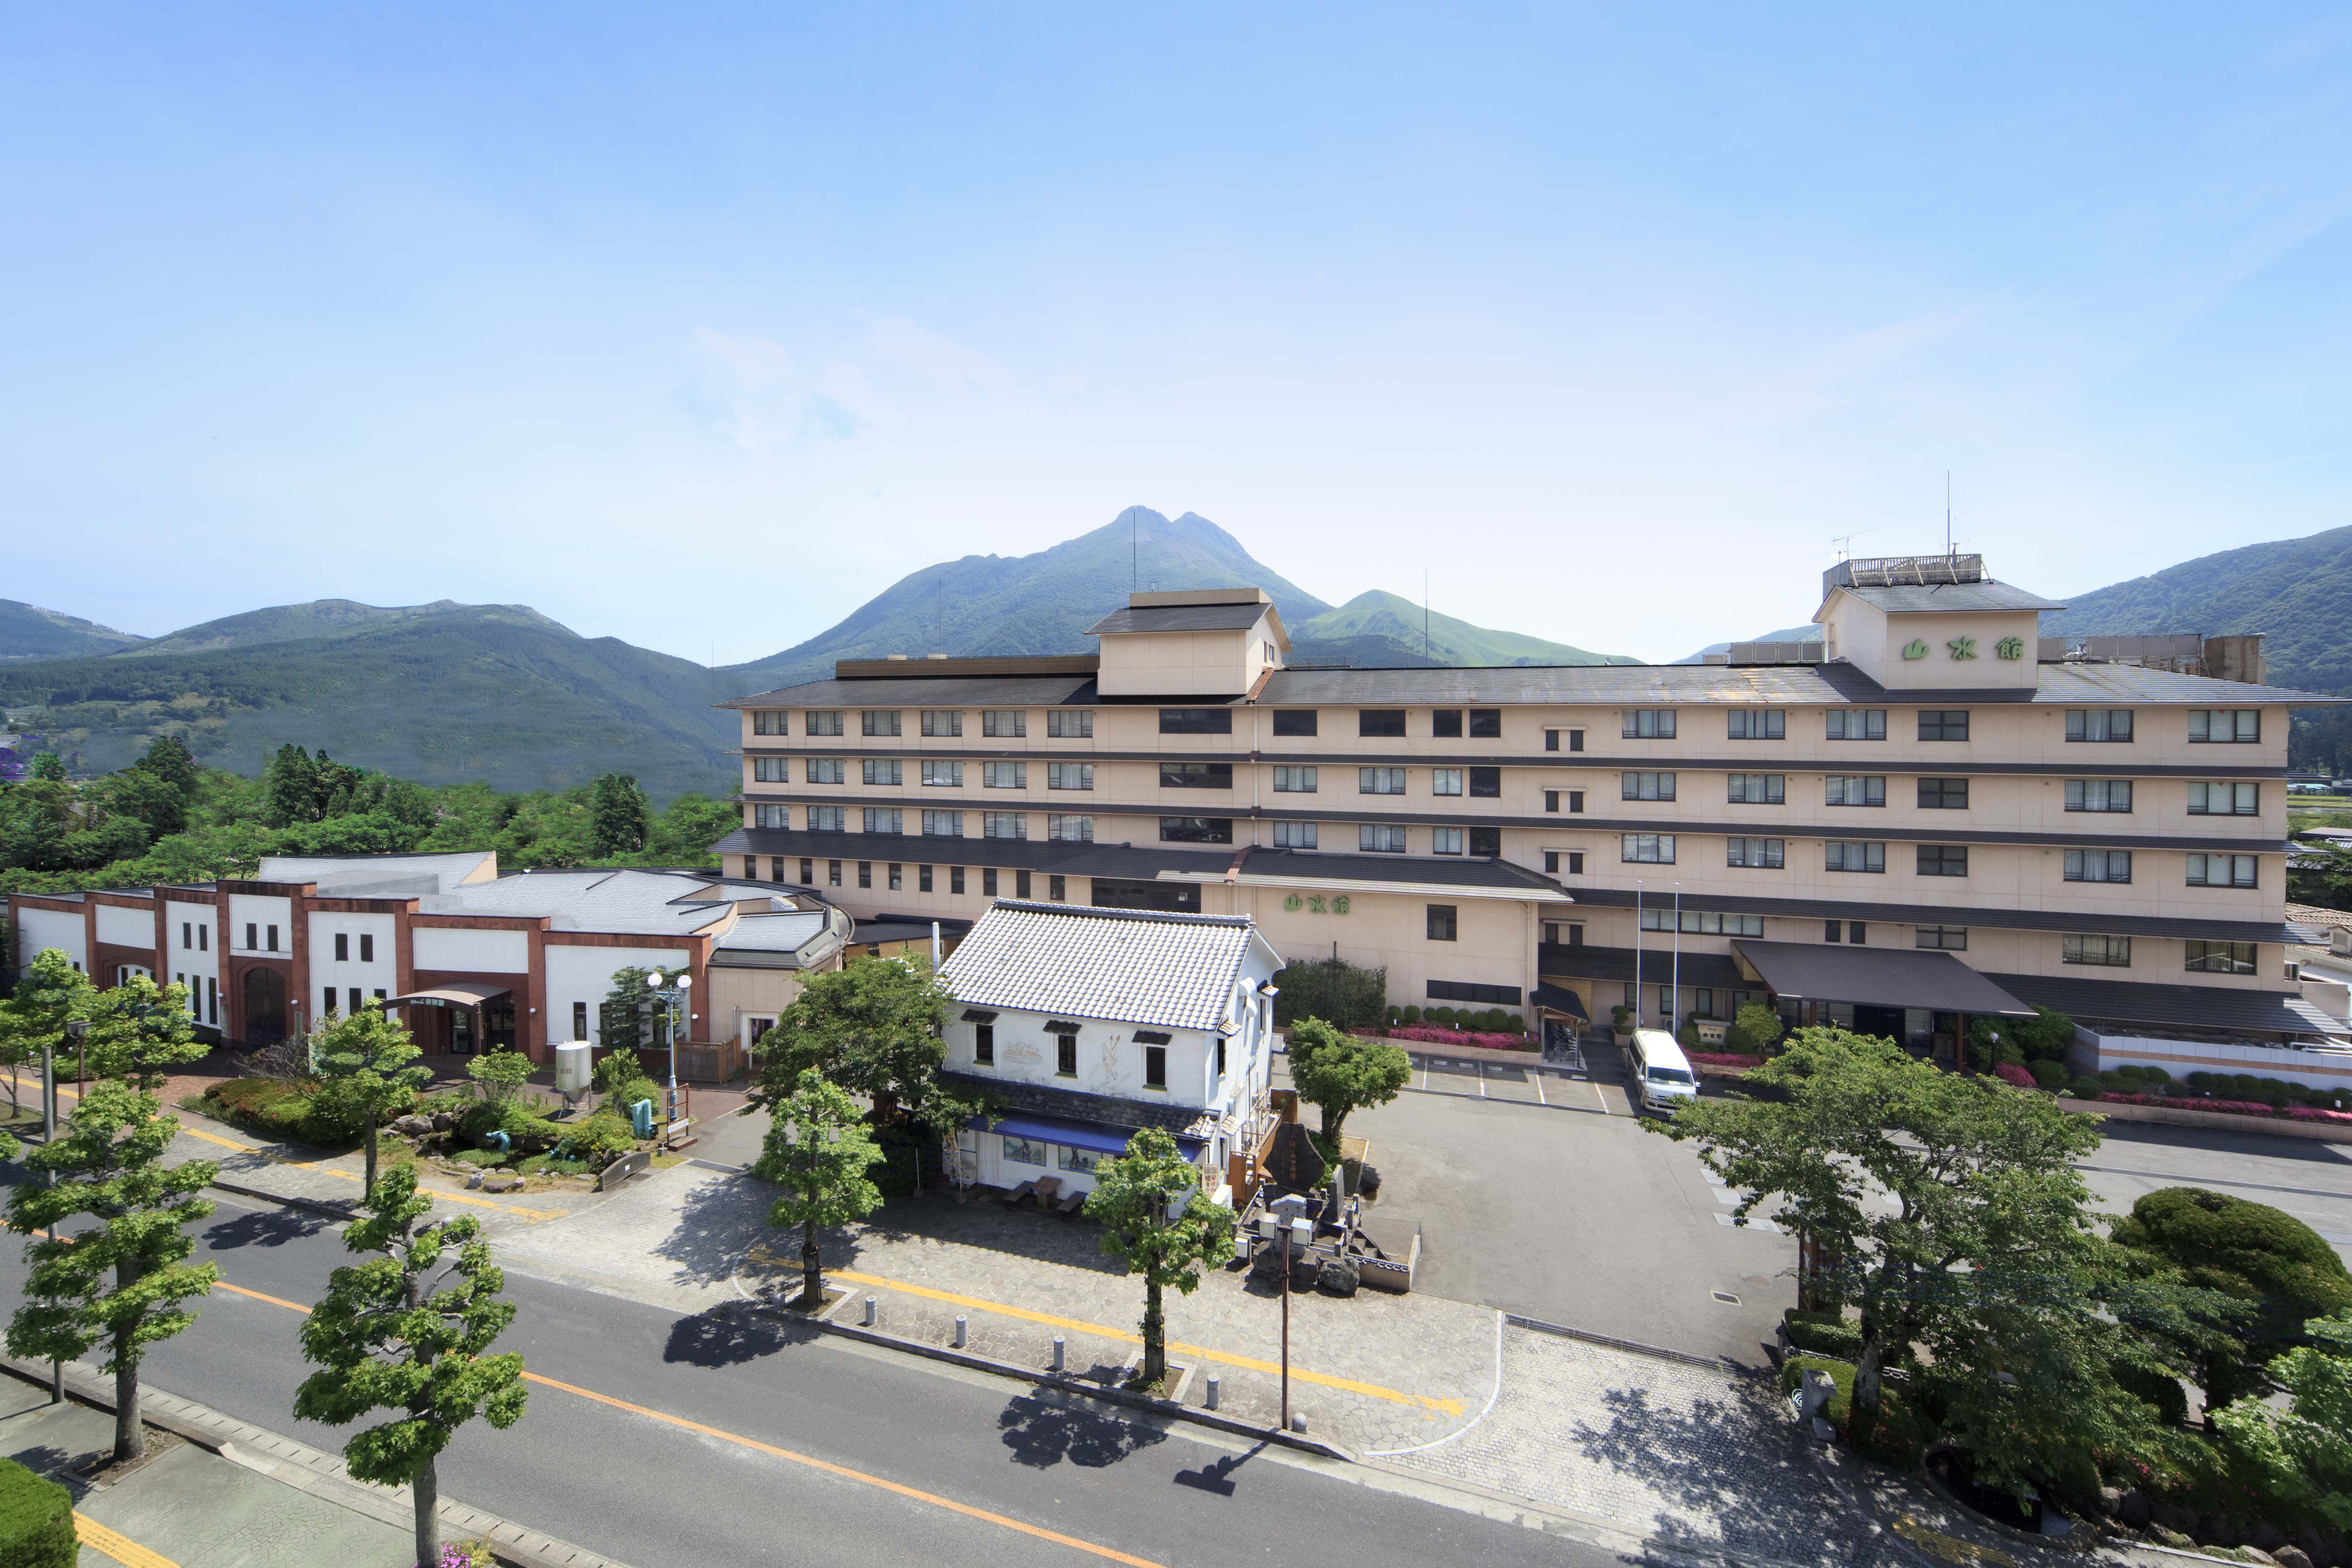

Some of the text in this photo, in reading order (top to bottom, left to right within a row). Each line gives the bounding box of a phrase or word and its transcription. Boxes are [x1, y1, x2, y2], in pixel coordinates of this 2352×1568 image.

[1903, 636, 2024, 660] 山水館
[1284, 894, 1350, 915] 山水館
